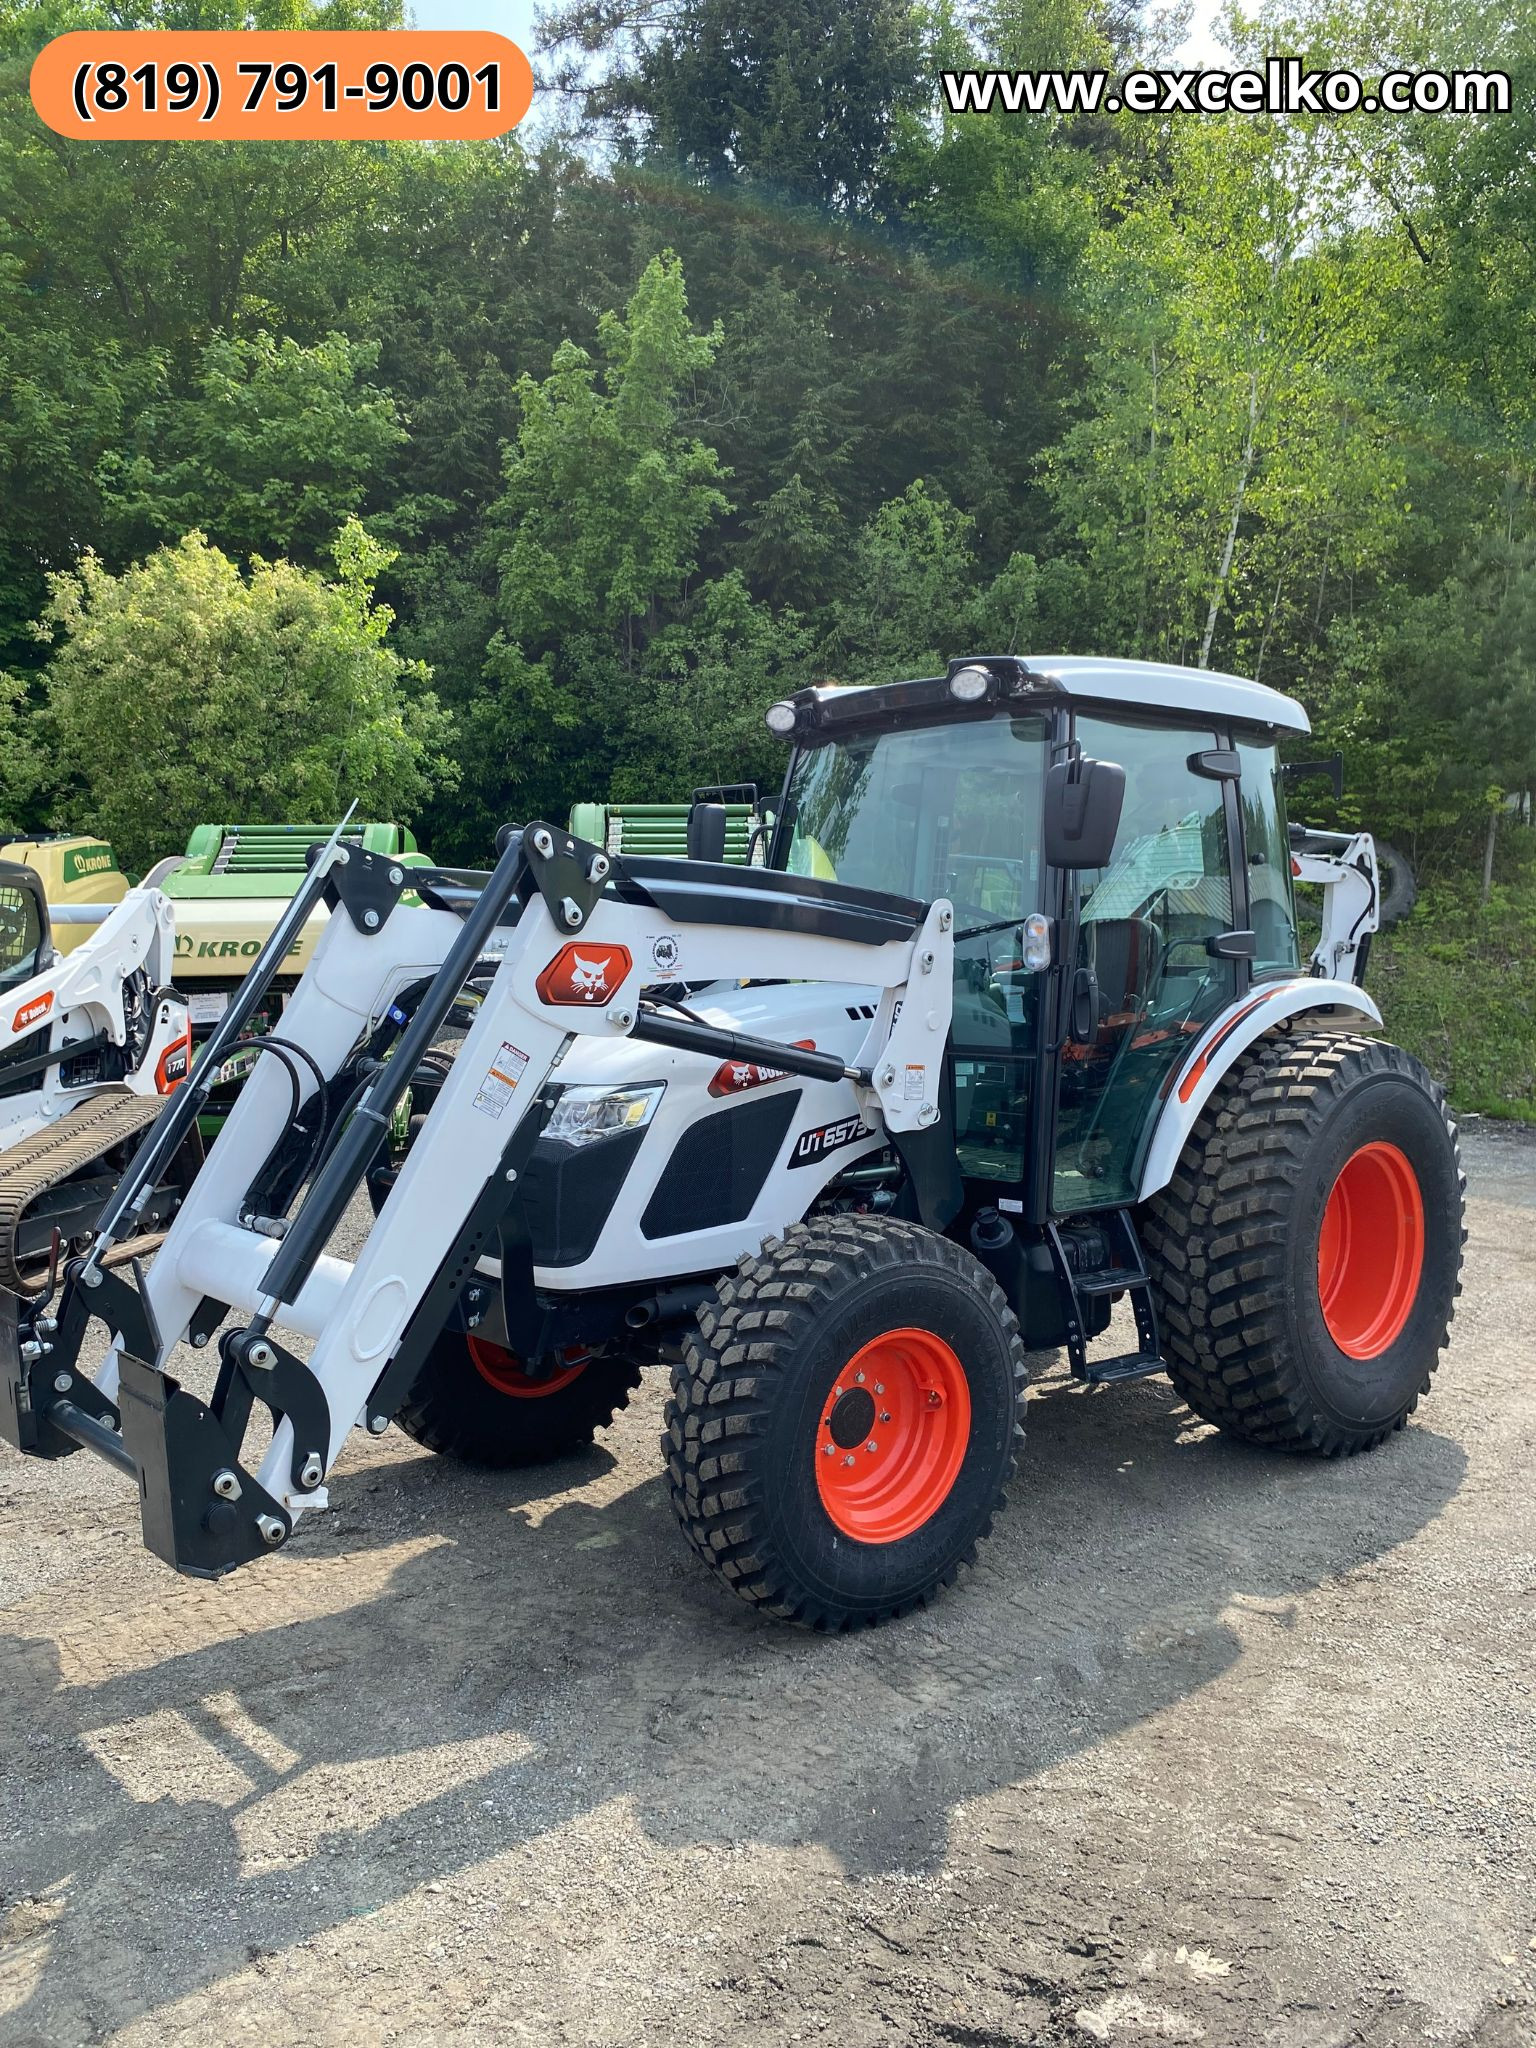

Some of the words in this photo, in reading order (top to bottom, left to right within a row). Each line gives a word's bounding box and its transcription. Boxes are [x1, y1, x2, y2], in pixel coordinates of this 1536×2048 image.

[85, 854, 112, 872] KRONE
[197, 940, 304, 958] KROE
[29, 1001, 48, 1020] Bobcat
[167, 1057, 186, 1075] T770
[798, 1118, 867, 1157] UT6573
